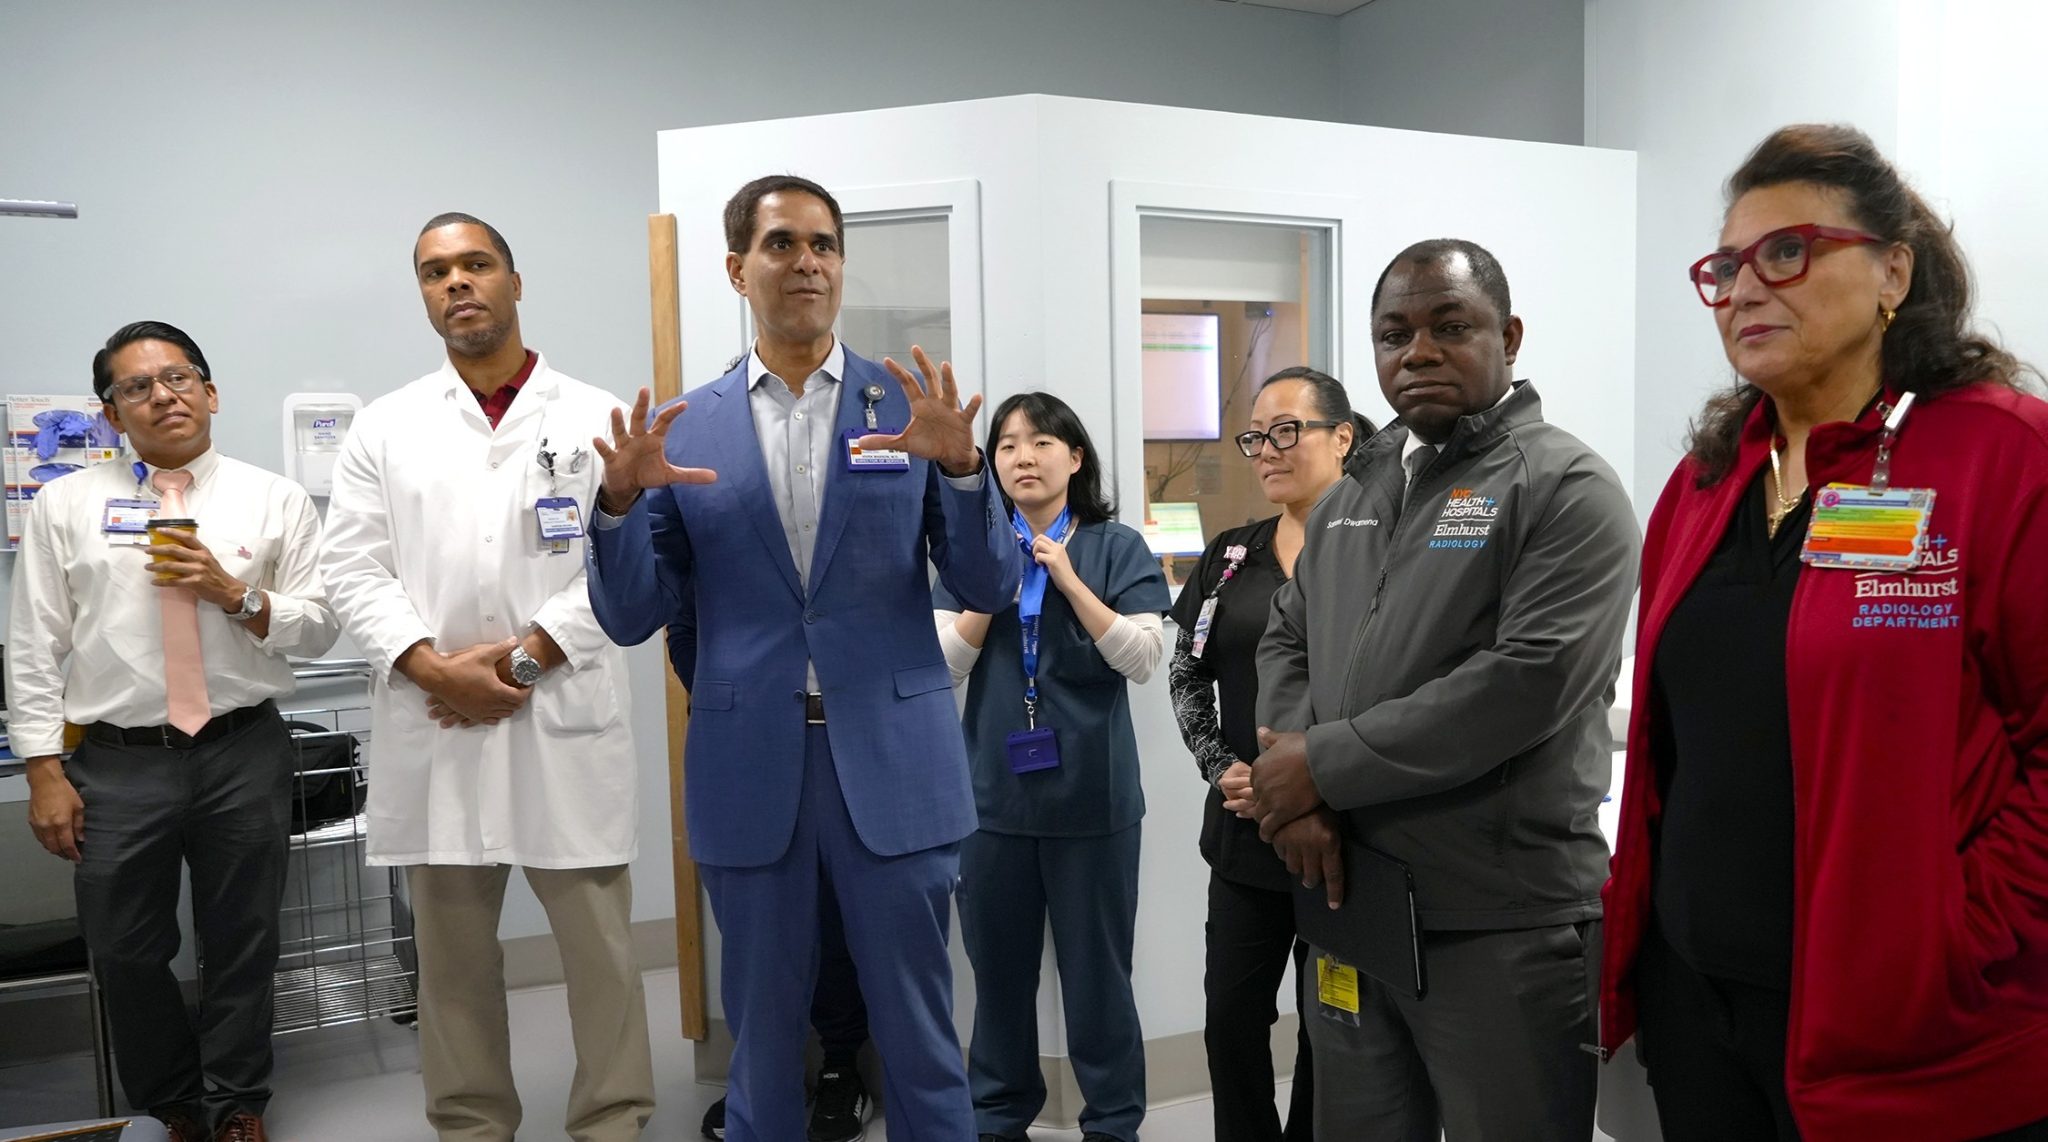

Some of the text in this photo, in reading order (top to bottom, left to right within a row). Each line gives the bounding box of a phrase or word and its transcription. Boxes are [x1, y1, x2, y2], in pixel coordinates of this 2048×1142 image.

[1451, 488, 1472, 498] NYC
[1441, 507, 1499, 518] HOSPITALS
[1433, 523, 1491, 537] Elmhurst
[1429, 539, 1487, 549] RADIOLOGY
[1854, 577, 1959, 598] Elmhurst
[1859, 603, 1953, 615] RADIOLOGY
[1852, 615, 1960, 628] DEPARTMENT
